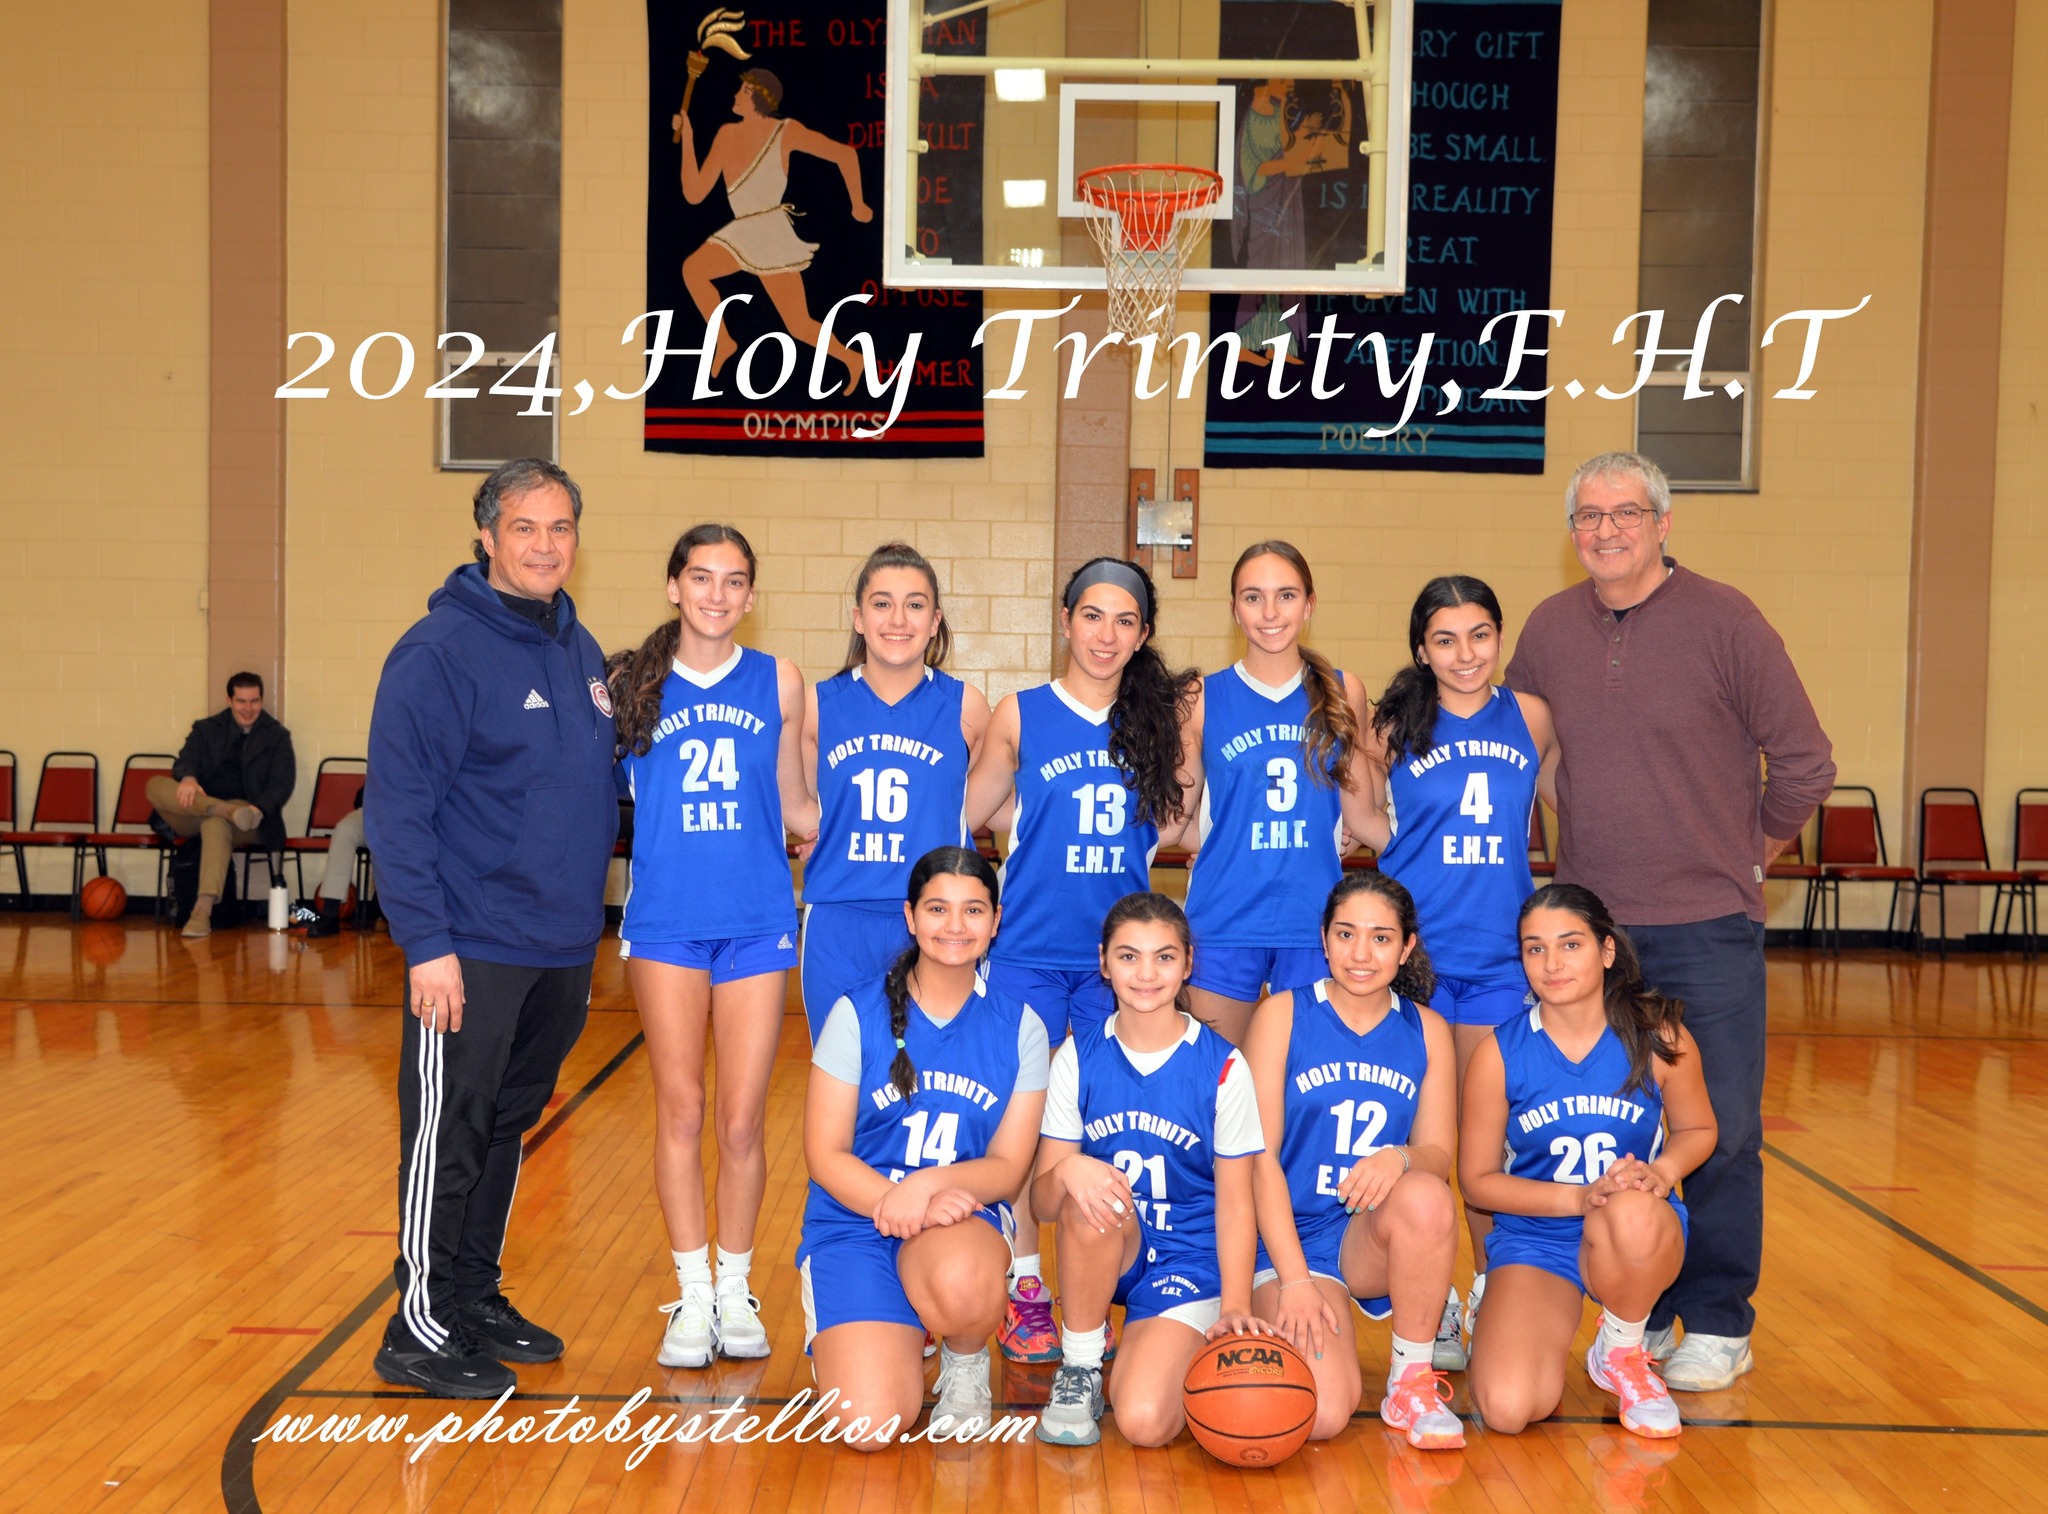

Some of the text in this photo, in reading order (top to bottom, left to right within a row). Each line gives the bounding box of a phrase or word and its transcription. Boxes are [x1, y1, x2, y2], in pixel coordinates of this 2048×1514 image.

[749, 17, 978, 47] THE OLYIAN
[1411, 81, 1510, 110] HOUGH
[847, 120, 977, 151] DIFULT
[1443, 133, 1543, 163] SMALL
[917, 176, 953, 205] OE
[1412, 184, 1539, 214] REALITY
[1406, 235, 1479, 265] REAT
[1458, 288, 1527, 315] WITH
[1343, 338, 1499, 367] AFETION
[876, 358, 974, 388] HMER
[743, 412, 885, 440] OLYMPICS
[1318, 423, 1435, 454] POETRY
[652, 703, 766, 744] HOLY TRINITY
[826, 734, 944, 769] HOLY TRINITY
[1220, 727, 1263, 762] HOLY
[1409, 740, 1529, 778] HOLY TRINITY
[679, 737, 740, 793] 24
[1039, 752, 1083, 782] HOLY
[851, 768, 909, 823] 16
[1266, 757, 1298, 812] 3
[1460, 772, 1493, 824] 4
[681, 801, 742, 833] E.H.T.
[1072, 783, 1127, 836] 13
[848, 832, 905, 863] E.H.T.
[1251, 820, 1309, 850] E.H.T.
[1443, 835, 1504, 864] E.H.T.
[1066, 845, 1125, 873] E.H.T.
[872, 1070, 999, 1112] HO TRINITY
[1296, 1061, 1417, 1101] HOLY TRINITY
[1330, 1099, 1388, 1157] 12
[1518, 1095, 1645, 1134] HOLY TRINITY
[902, 1110, 959, 1167] 14
[1085, 1111, 1201, 1151] HOLY TRINITY
[1550, 1132, 1618, 1184] 26
[1113, 1150, 1167, 1199] 21
[1152, 1274, 1200, 1294] HOLY TRINITY
[1216, 1347, 1284, 1371] NCAA
[1248, 1366, 1285, 1377] ENCORE
